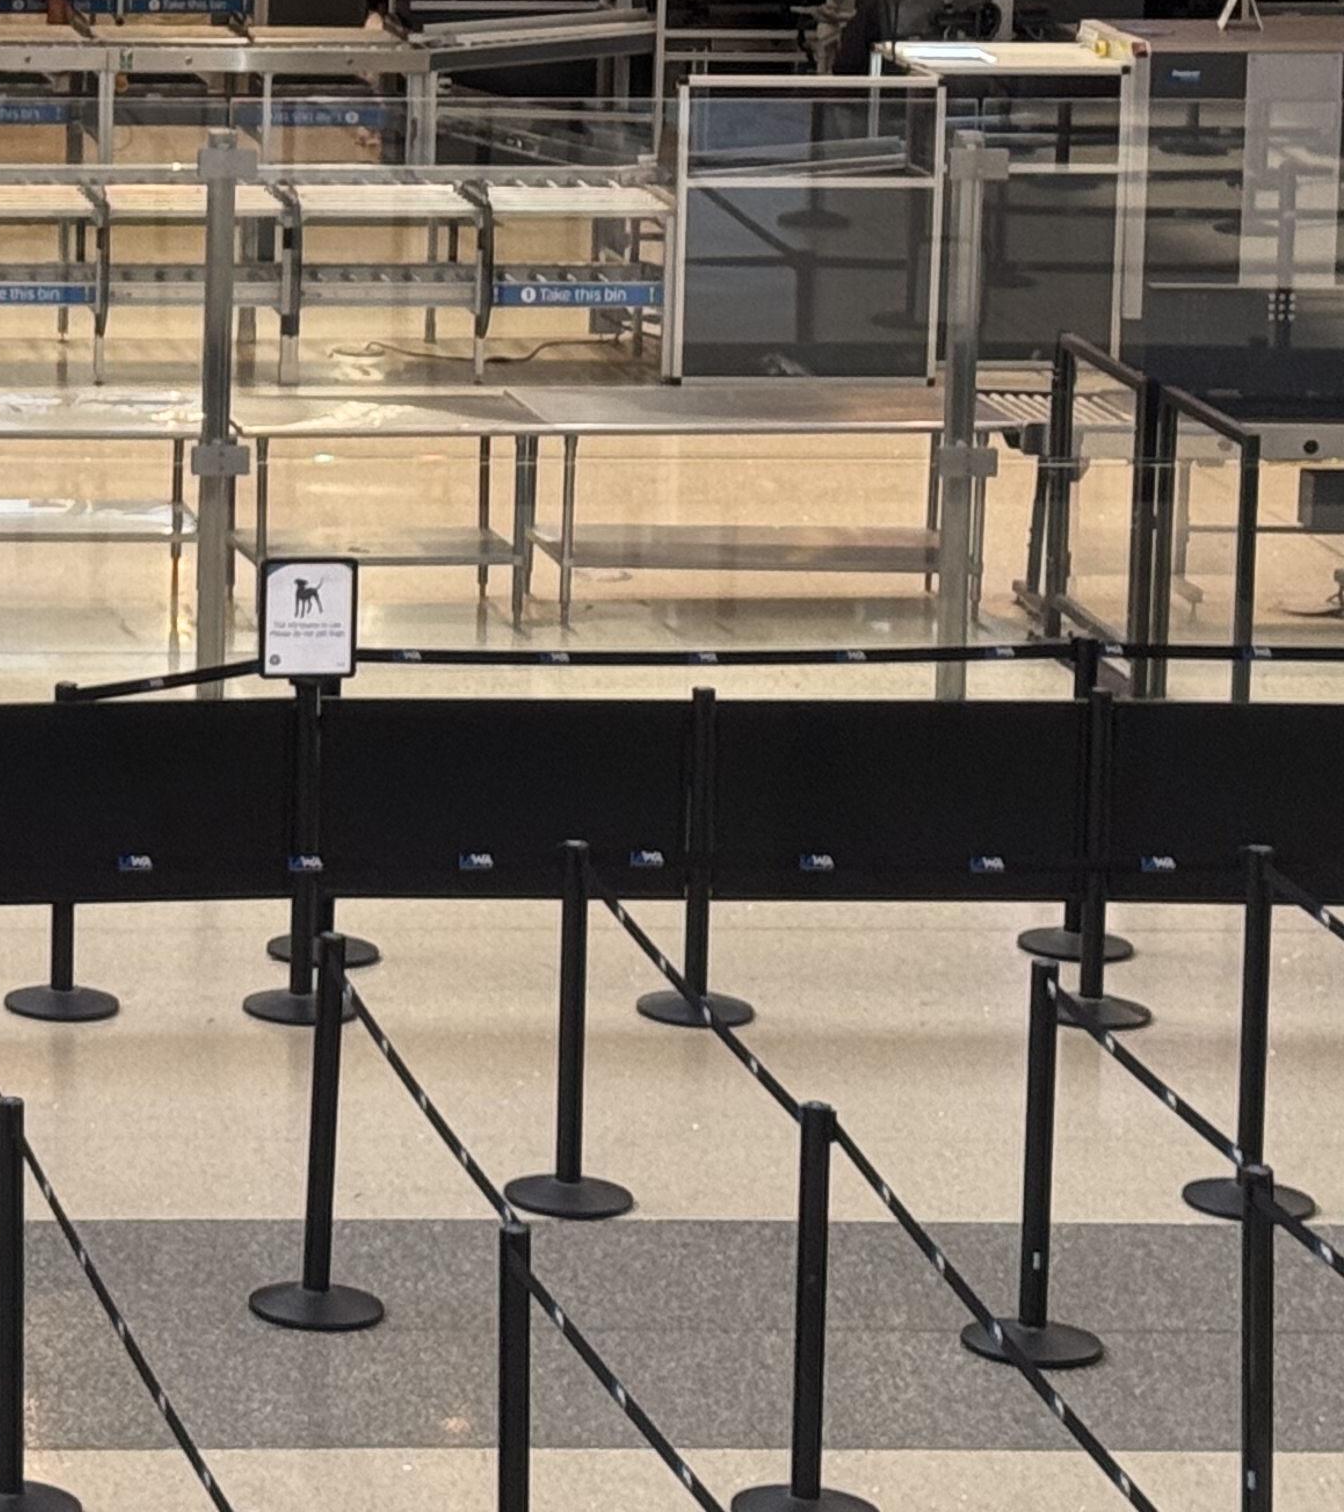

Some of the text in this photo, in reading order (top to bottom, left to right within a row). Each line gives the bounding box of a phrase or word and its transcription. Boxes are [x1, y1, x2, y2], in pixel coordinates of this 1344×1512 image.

[10, 287, 35, 301] this
[38, 287, 60, 301] bin
[541, 288, 626, 302] Take this bin
